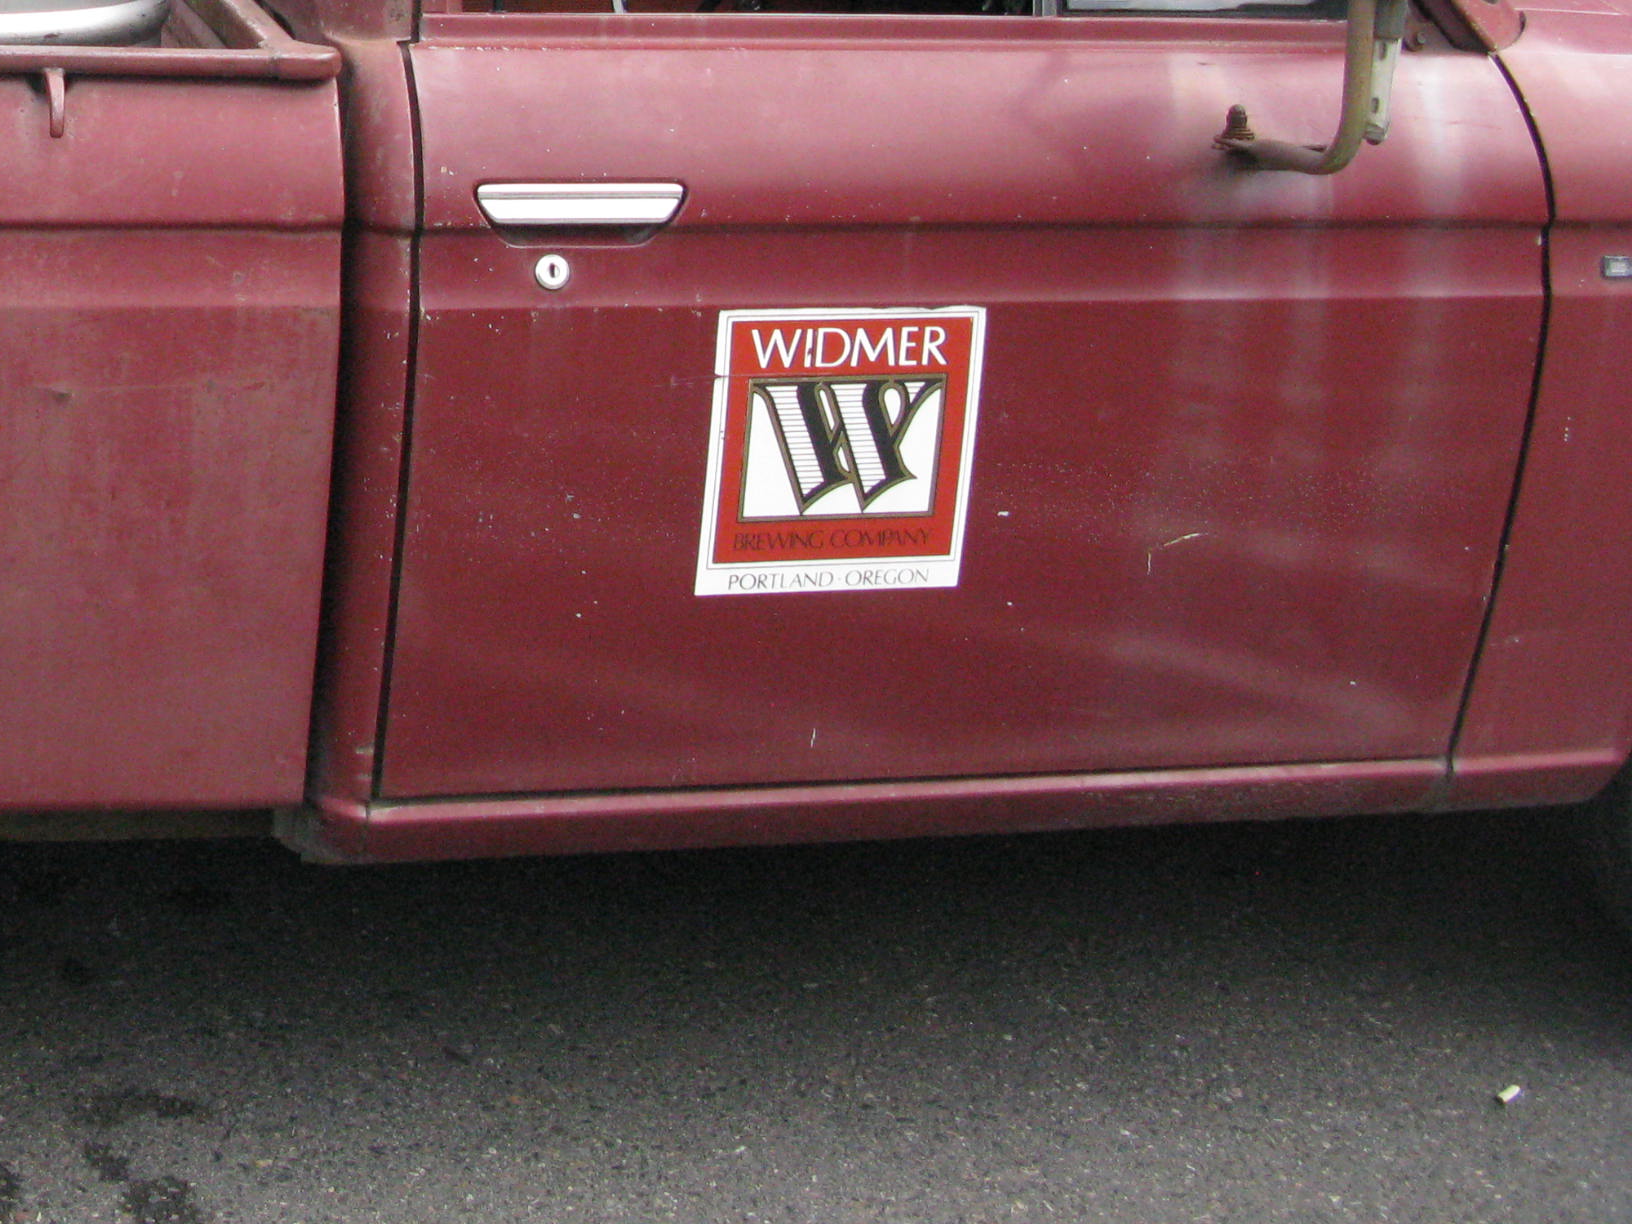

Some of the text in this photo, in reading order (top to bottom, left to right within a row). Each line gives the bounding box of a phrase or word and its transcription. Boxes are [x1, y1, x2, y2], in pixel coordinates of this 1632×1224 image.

[751, 326, 948, 369] WIDMER
[732, 528, 934, 552] BREWING COMPANY
[727, 567, 930, 591] PORTLAND OREGON
